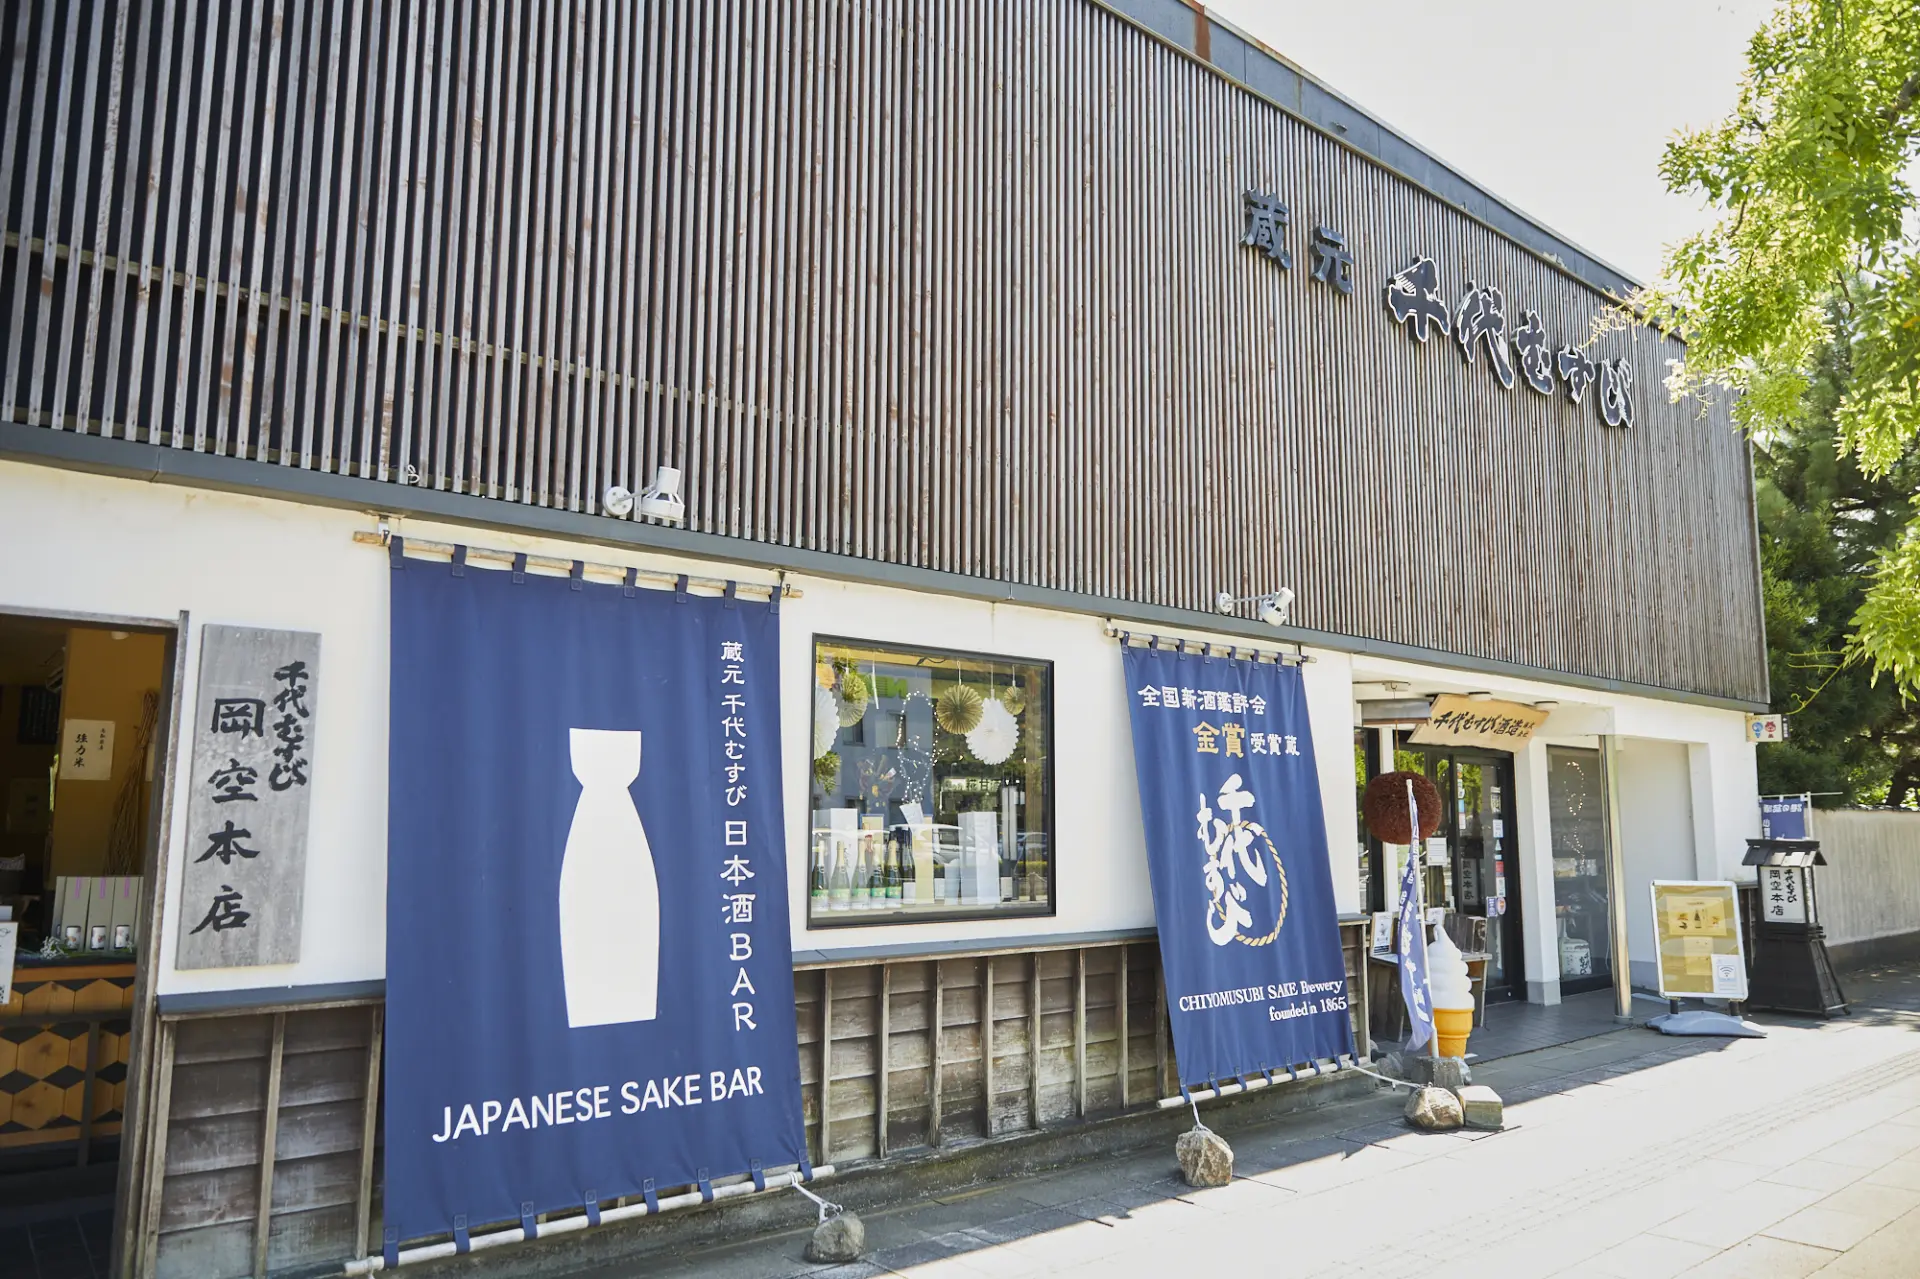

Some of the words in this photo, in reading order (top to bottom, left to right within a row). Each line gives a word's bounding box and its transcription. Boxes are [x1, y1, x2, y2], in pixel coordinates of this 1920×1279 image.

[720, 640, 745, 685] 蔵元
[1138, 684, 1267, 715] 全国新酒鑑評会
[268, 660, 309, 792] 千代むすび
[721, 694, 748, 807] 千代むすび
[189, 697, 267, 936] 岡空本店
[1769, 870, 1784, 916] 岡空本店
[1179, 986, 1265, 1012] CHIYOMUSUBI
[1267, 982, 1299, 1000] SAKE
[1320, 996, 1347, 1013] 1865
[432, 1085, 612, 1143] JAPANESE
[620, 1074, 703, 1115] SAKE
[709, 1066, 764, 1102] BAR
